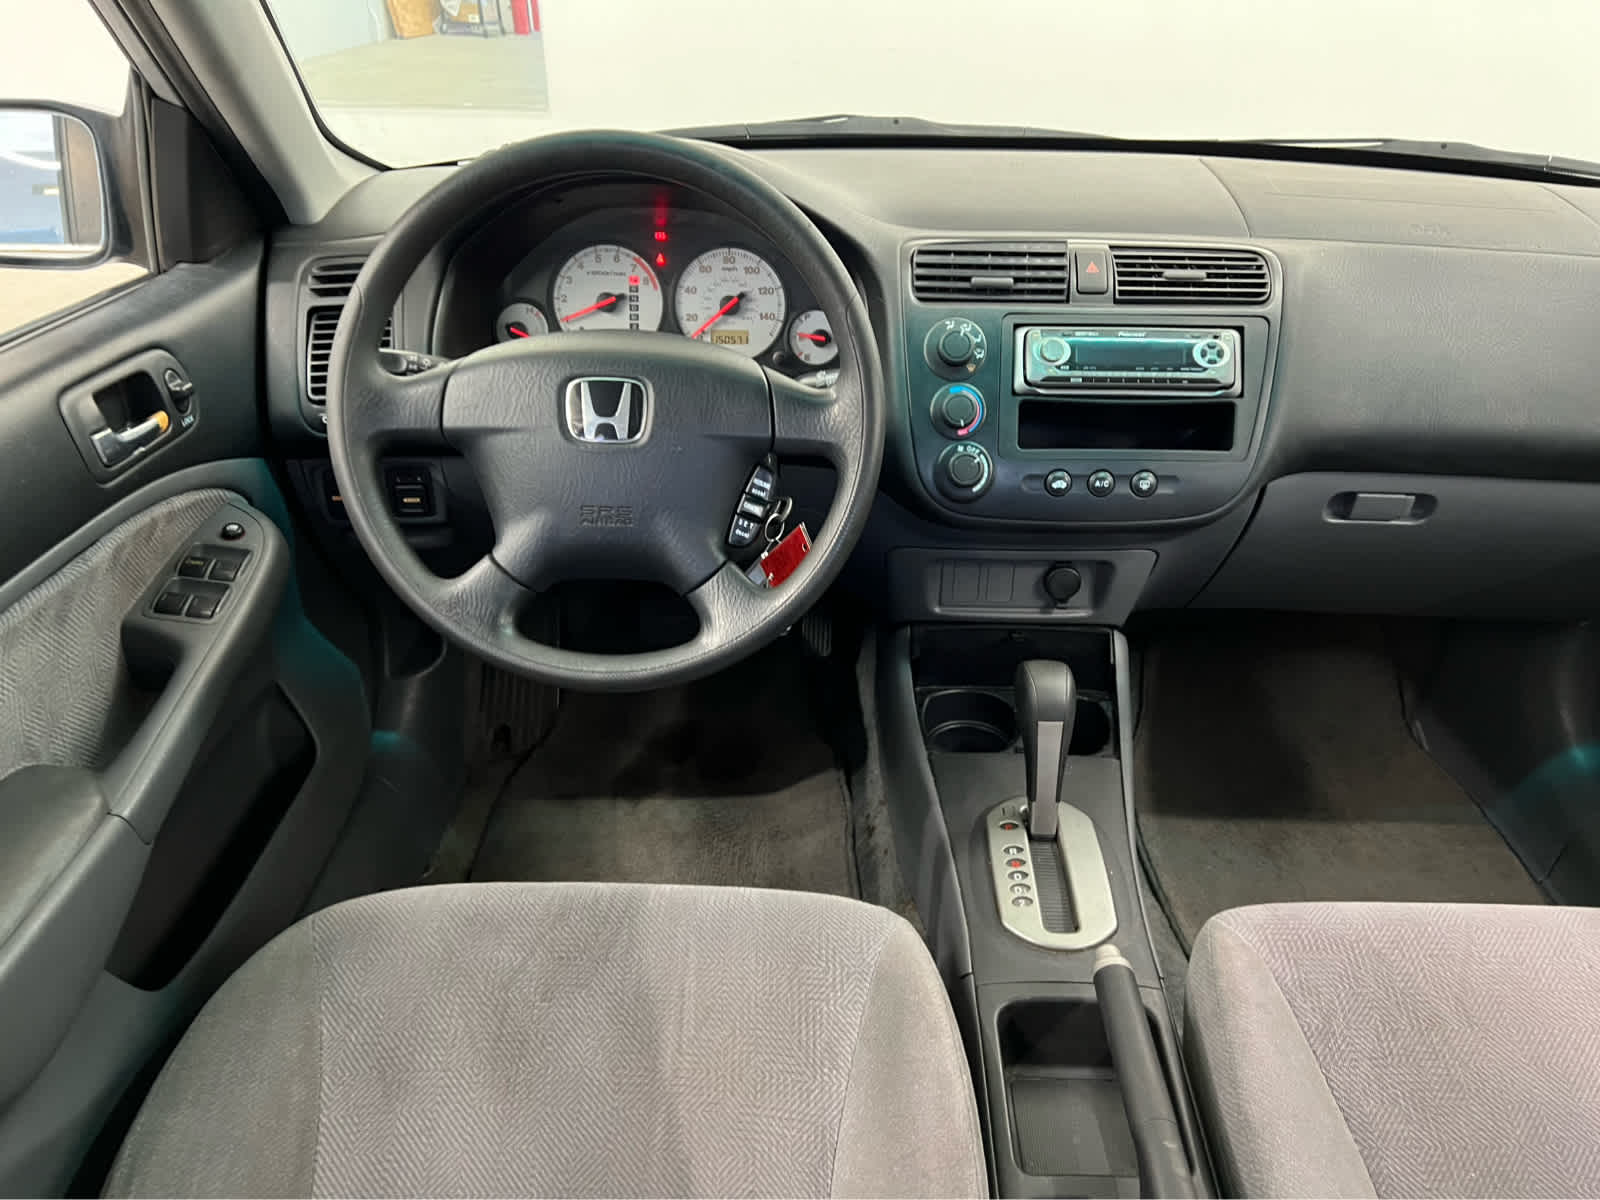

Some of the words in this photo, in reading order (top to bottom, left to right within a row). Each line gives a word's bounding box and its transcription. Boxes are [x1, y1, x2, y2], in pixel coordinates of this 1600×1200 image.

[594, 254, 602, 263] 5
[613, 254, 620, 263] 6
[723, 255, 736, 264] 80
[631, 263, 638, 273] 7
[744, 266, 760, 274] 100
[684, 286, 697, 295] 40
[758, 287, 775, 295] 120
[561, 294, 567, 303] 2
[686, 313, 698, 321] 20
[760, 312, 776, 321] 140
[1094, 479, 1110, 489] A/C
